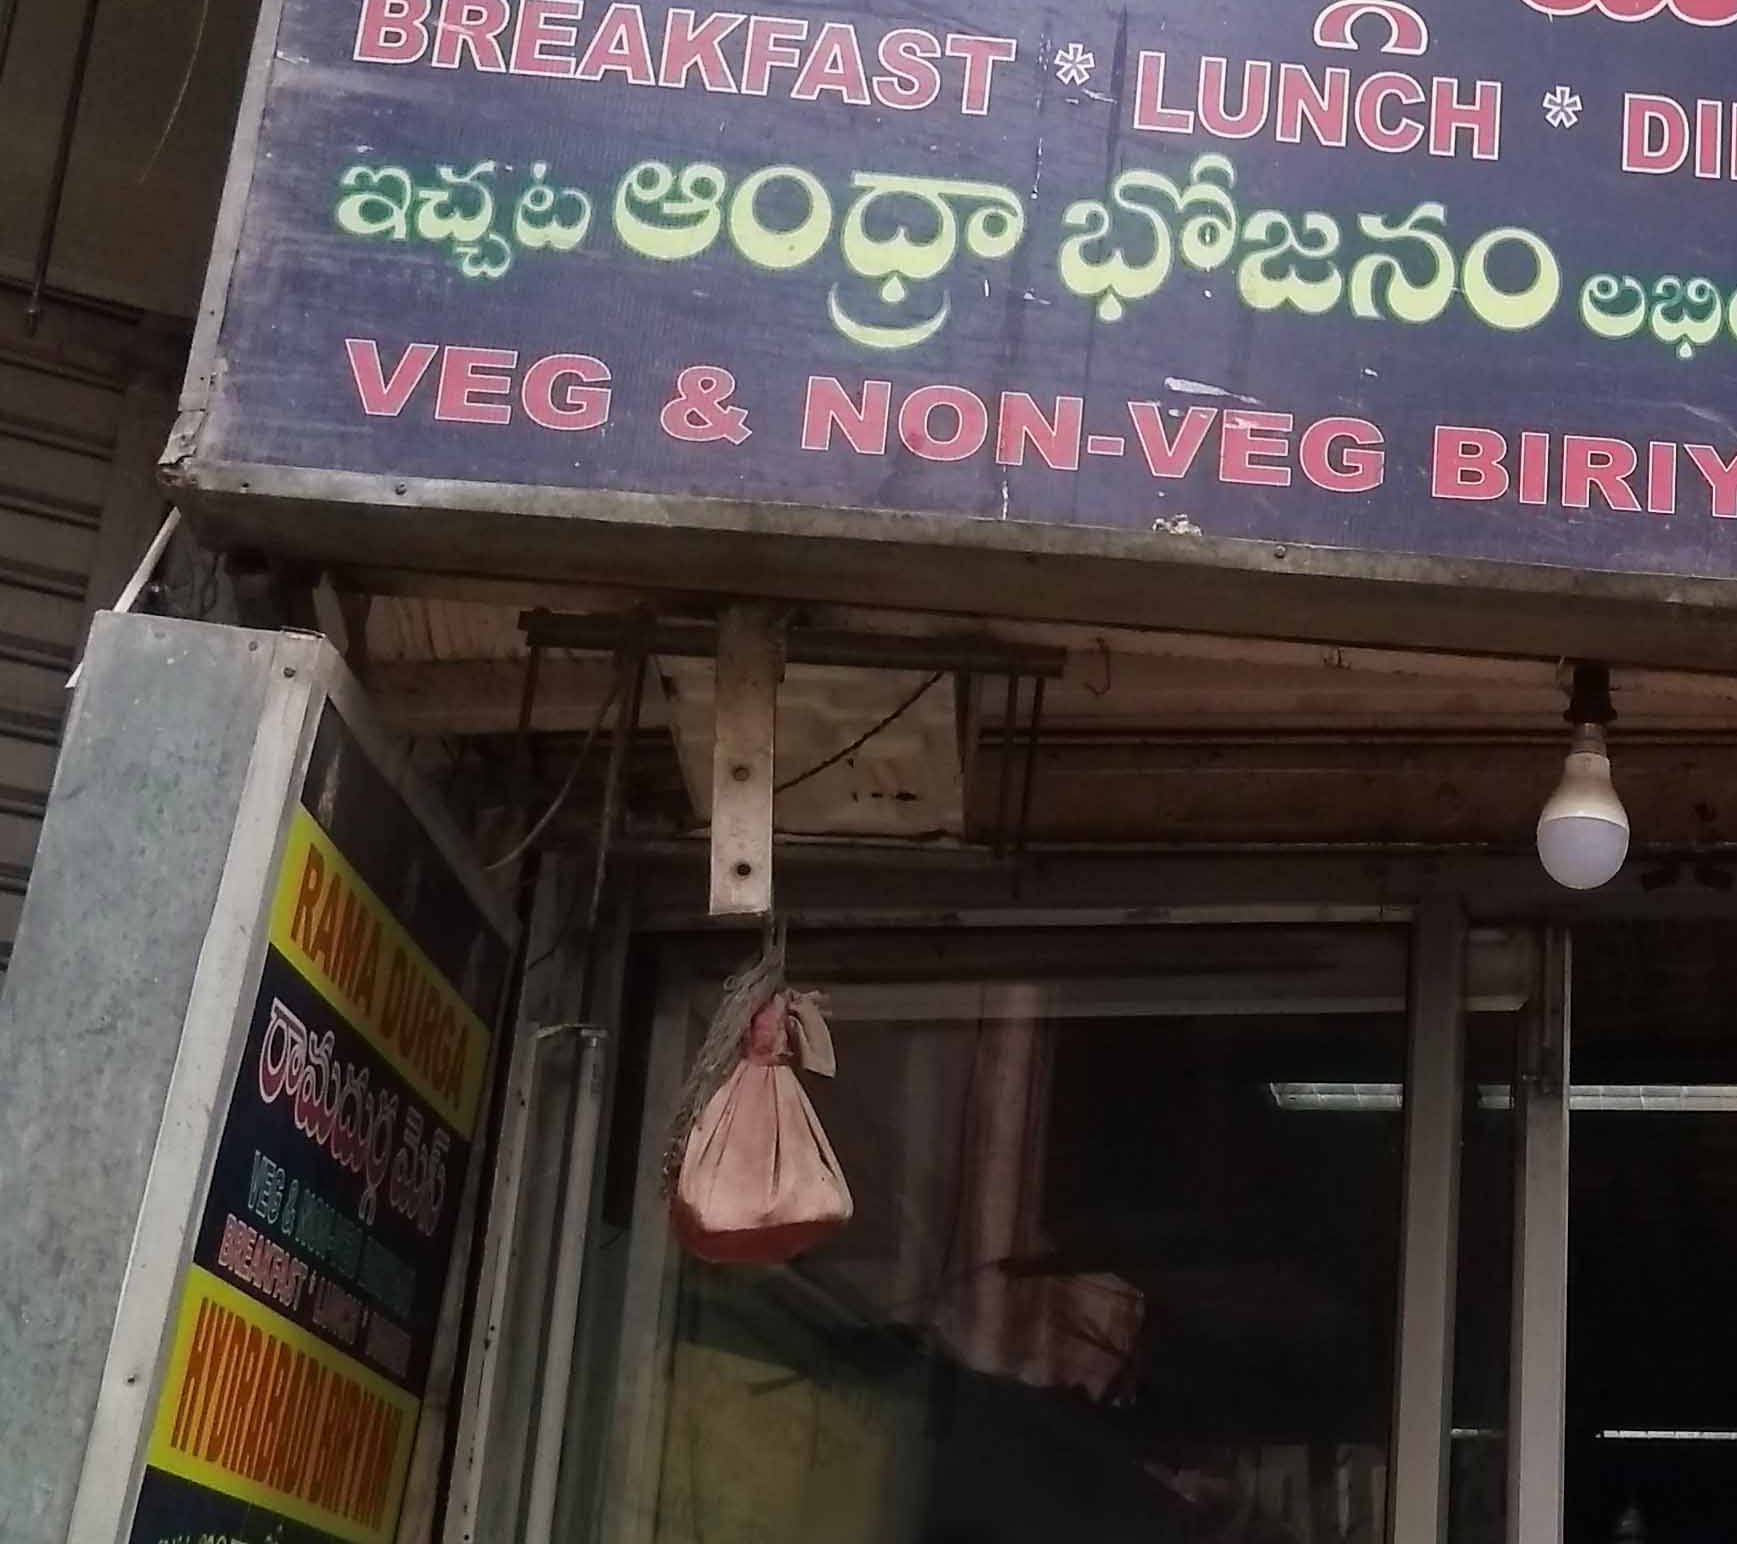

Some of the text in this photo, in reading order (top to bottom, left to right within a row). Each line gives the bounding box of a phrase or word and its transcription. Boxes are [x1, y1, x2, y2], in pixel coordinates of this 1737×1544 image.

[1132, 50, 1502, 160] LUNCH
[335, 159, 593, 280] ఇచ్చట
[613, 158, 1024, 349] ఆంధ్రా
[1059, 153, 1562, 331] భోజనం
[344, 338, 613, 431] VEG
[659, 365, 754, 444] &
[801, 376, 1385, 493] NON-VEG
[289, 841, 471, 1110] RAMA DURGA
[246, 1148, 288, 1225] VEG
